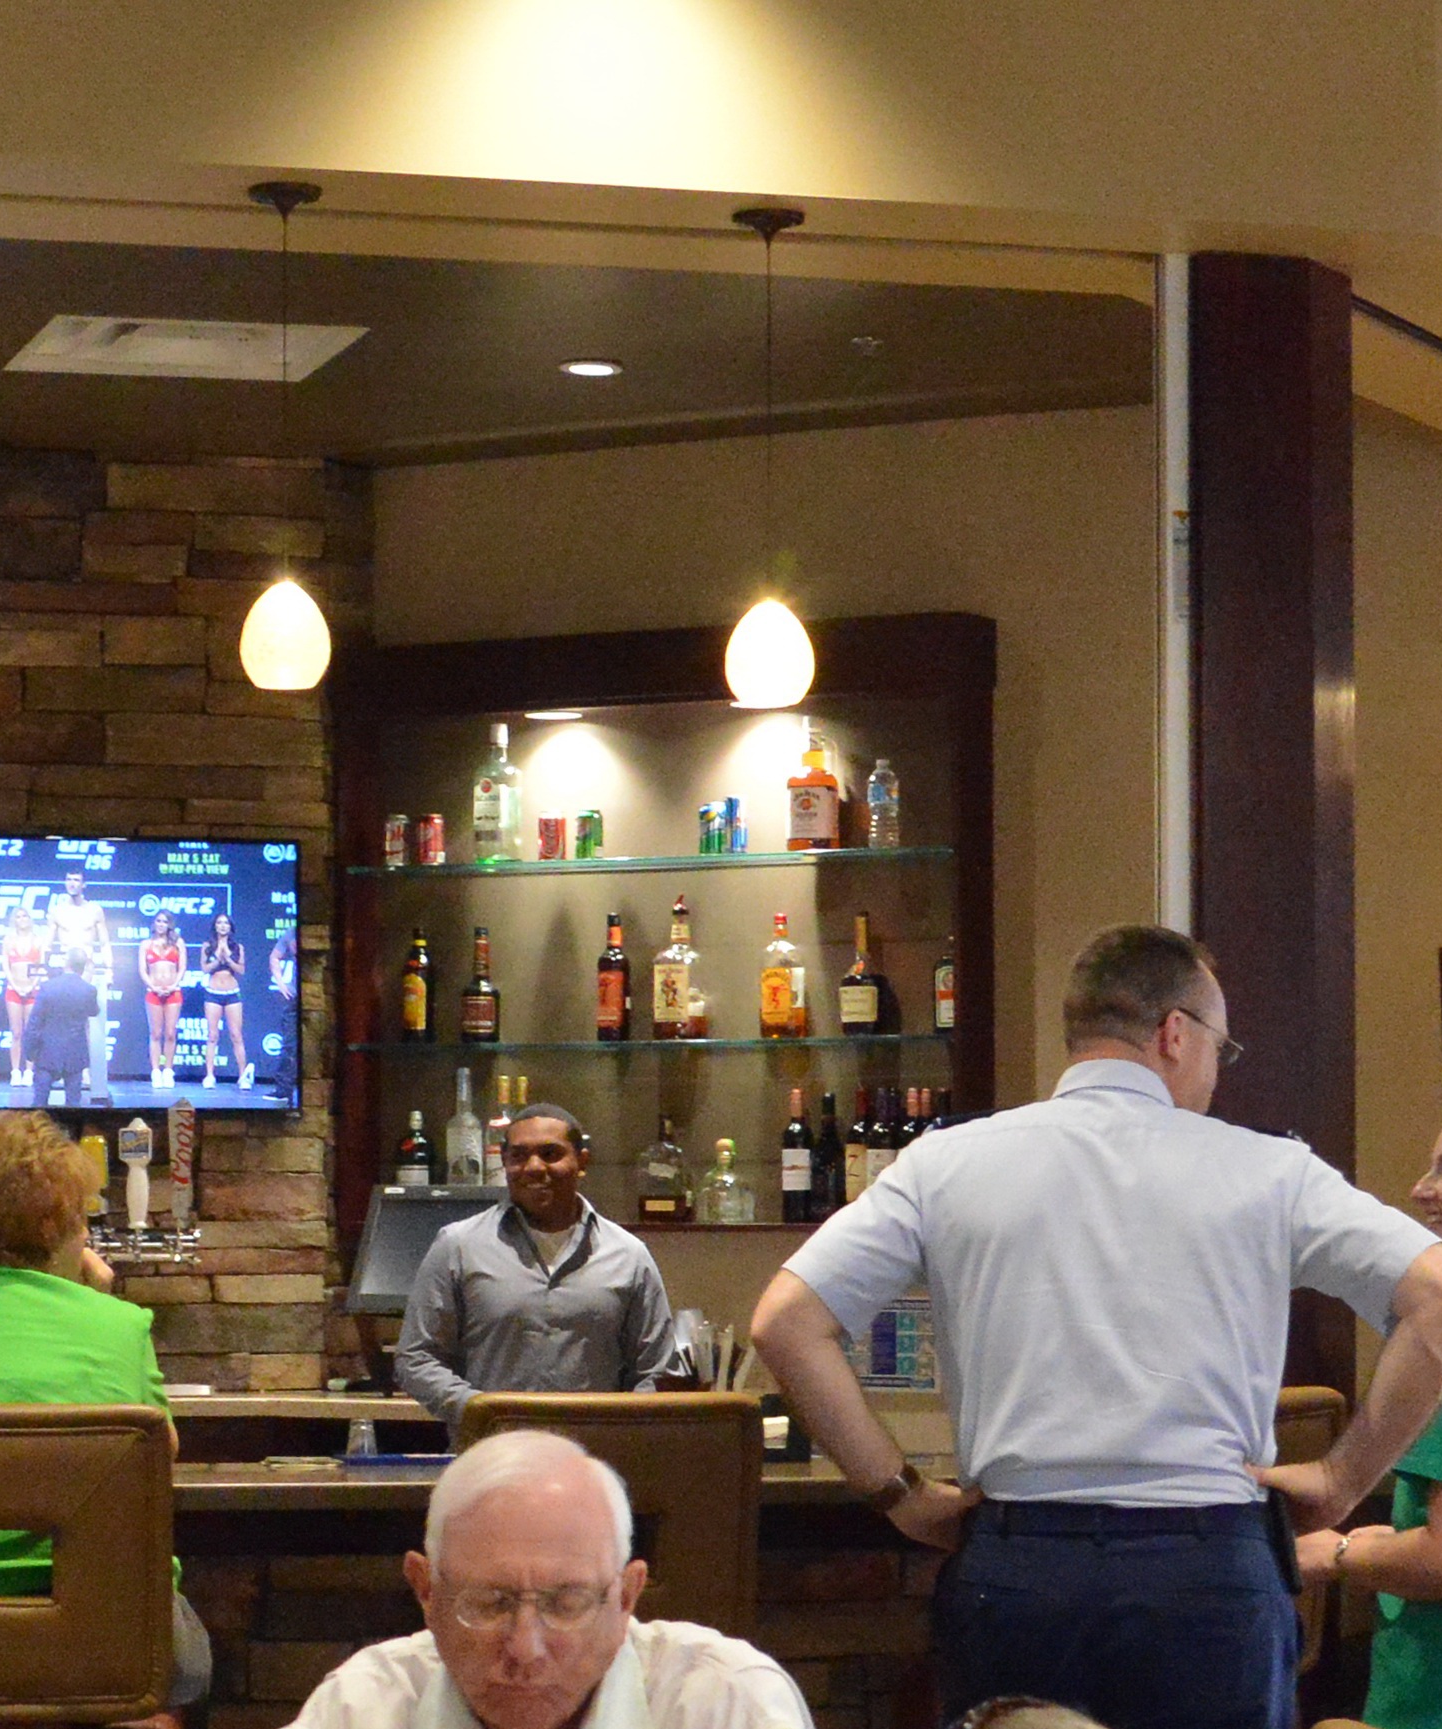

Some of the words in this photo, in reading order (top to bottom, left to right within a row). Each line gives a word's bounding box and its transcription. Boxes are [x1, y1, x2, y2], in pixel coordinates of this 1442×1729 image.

[85, 854, 113, 870] 196
[167, 853, 190, 864] MAR
[202, 853, 220, 864] SAT
[199, 897, 215, 914] 2
